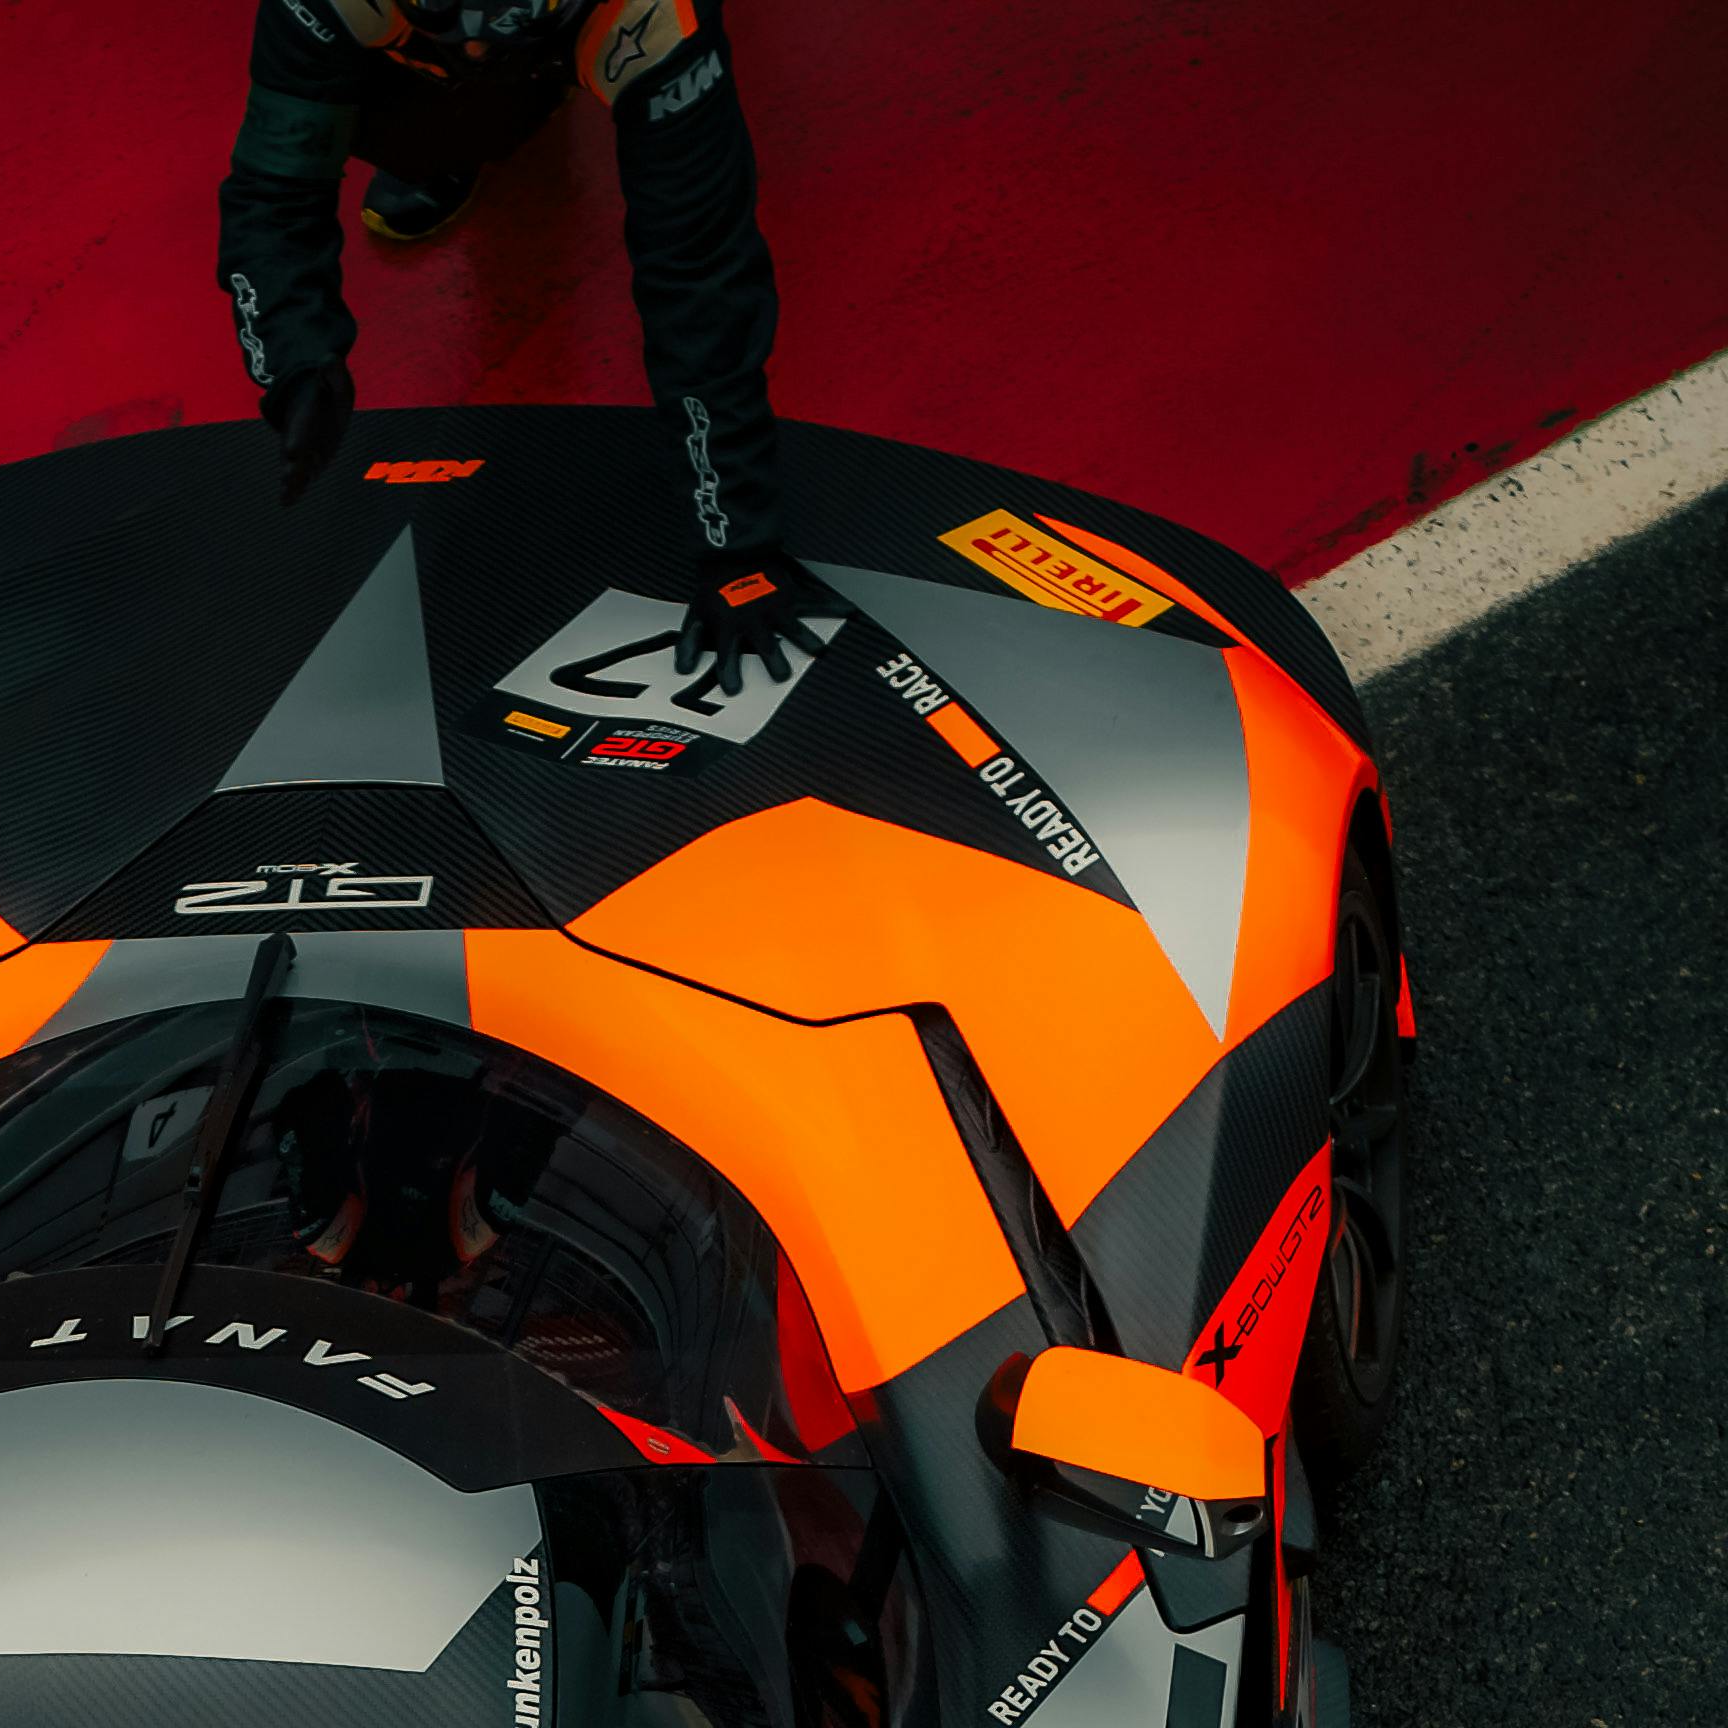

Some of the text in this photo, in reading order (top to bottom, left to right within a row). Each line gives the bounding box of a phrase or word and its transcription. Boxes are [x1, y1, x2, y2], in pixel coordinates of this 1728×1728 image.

[969, 526, 1139, 622] PIRELLI
[876, 651, 950, 715] RACE
[588, 735, 688, 761] GT2
[978, 756, 1102, 878] READY TO
[174, 873, 434, 915] GT2
[988, 1606, 1104, 1727] READY TO
